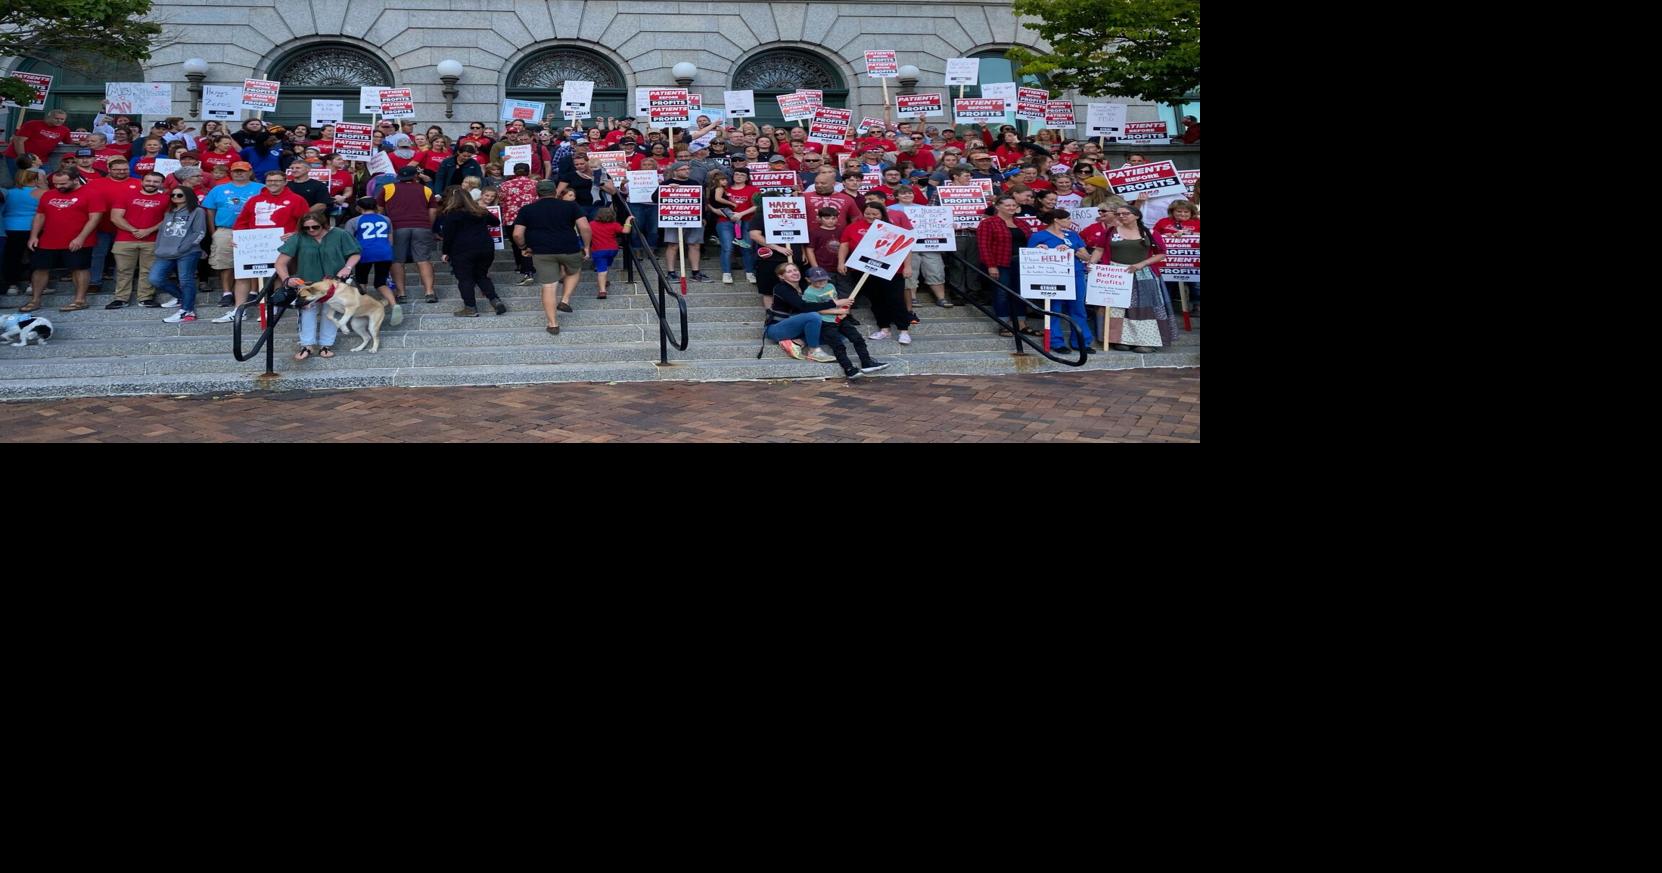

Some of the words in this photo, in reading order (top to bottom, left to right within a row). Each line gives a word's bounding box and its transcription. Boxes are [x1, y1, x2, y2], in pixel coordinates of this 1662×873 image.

[816, 108, 850, 116] PATIENTS
[1108, 163, 1171, 179] PATIENTS
[1125, 173, 1160, 182] BEFORE
[1116, 179, 1176, 193] PROFITS
[1071, 210, 1092, 219] EROS
[360, 221, 388, 240] 22
